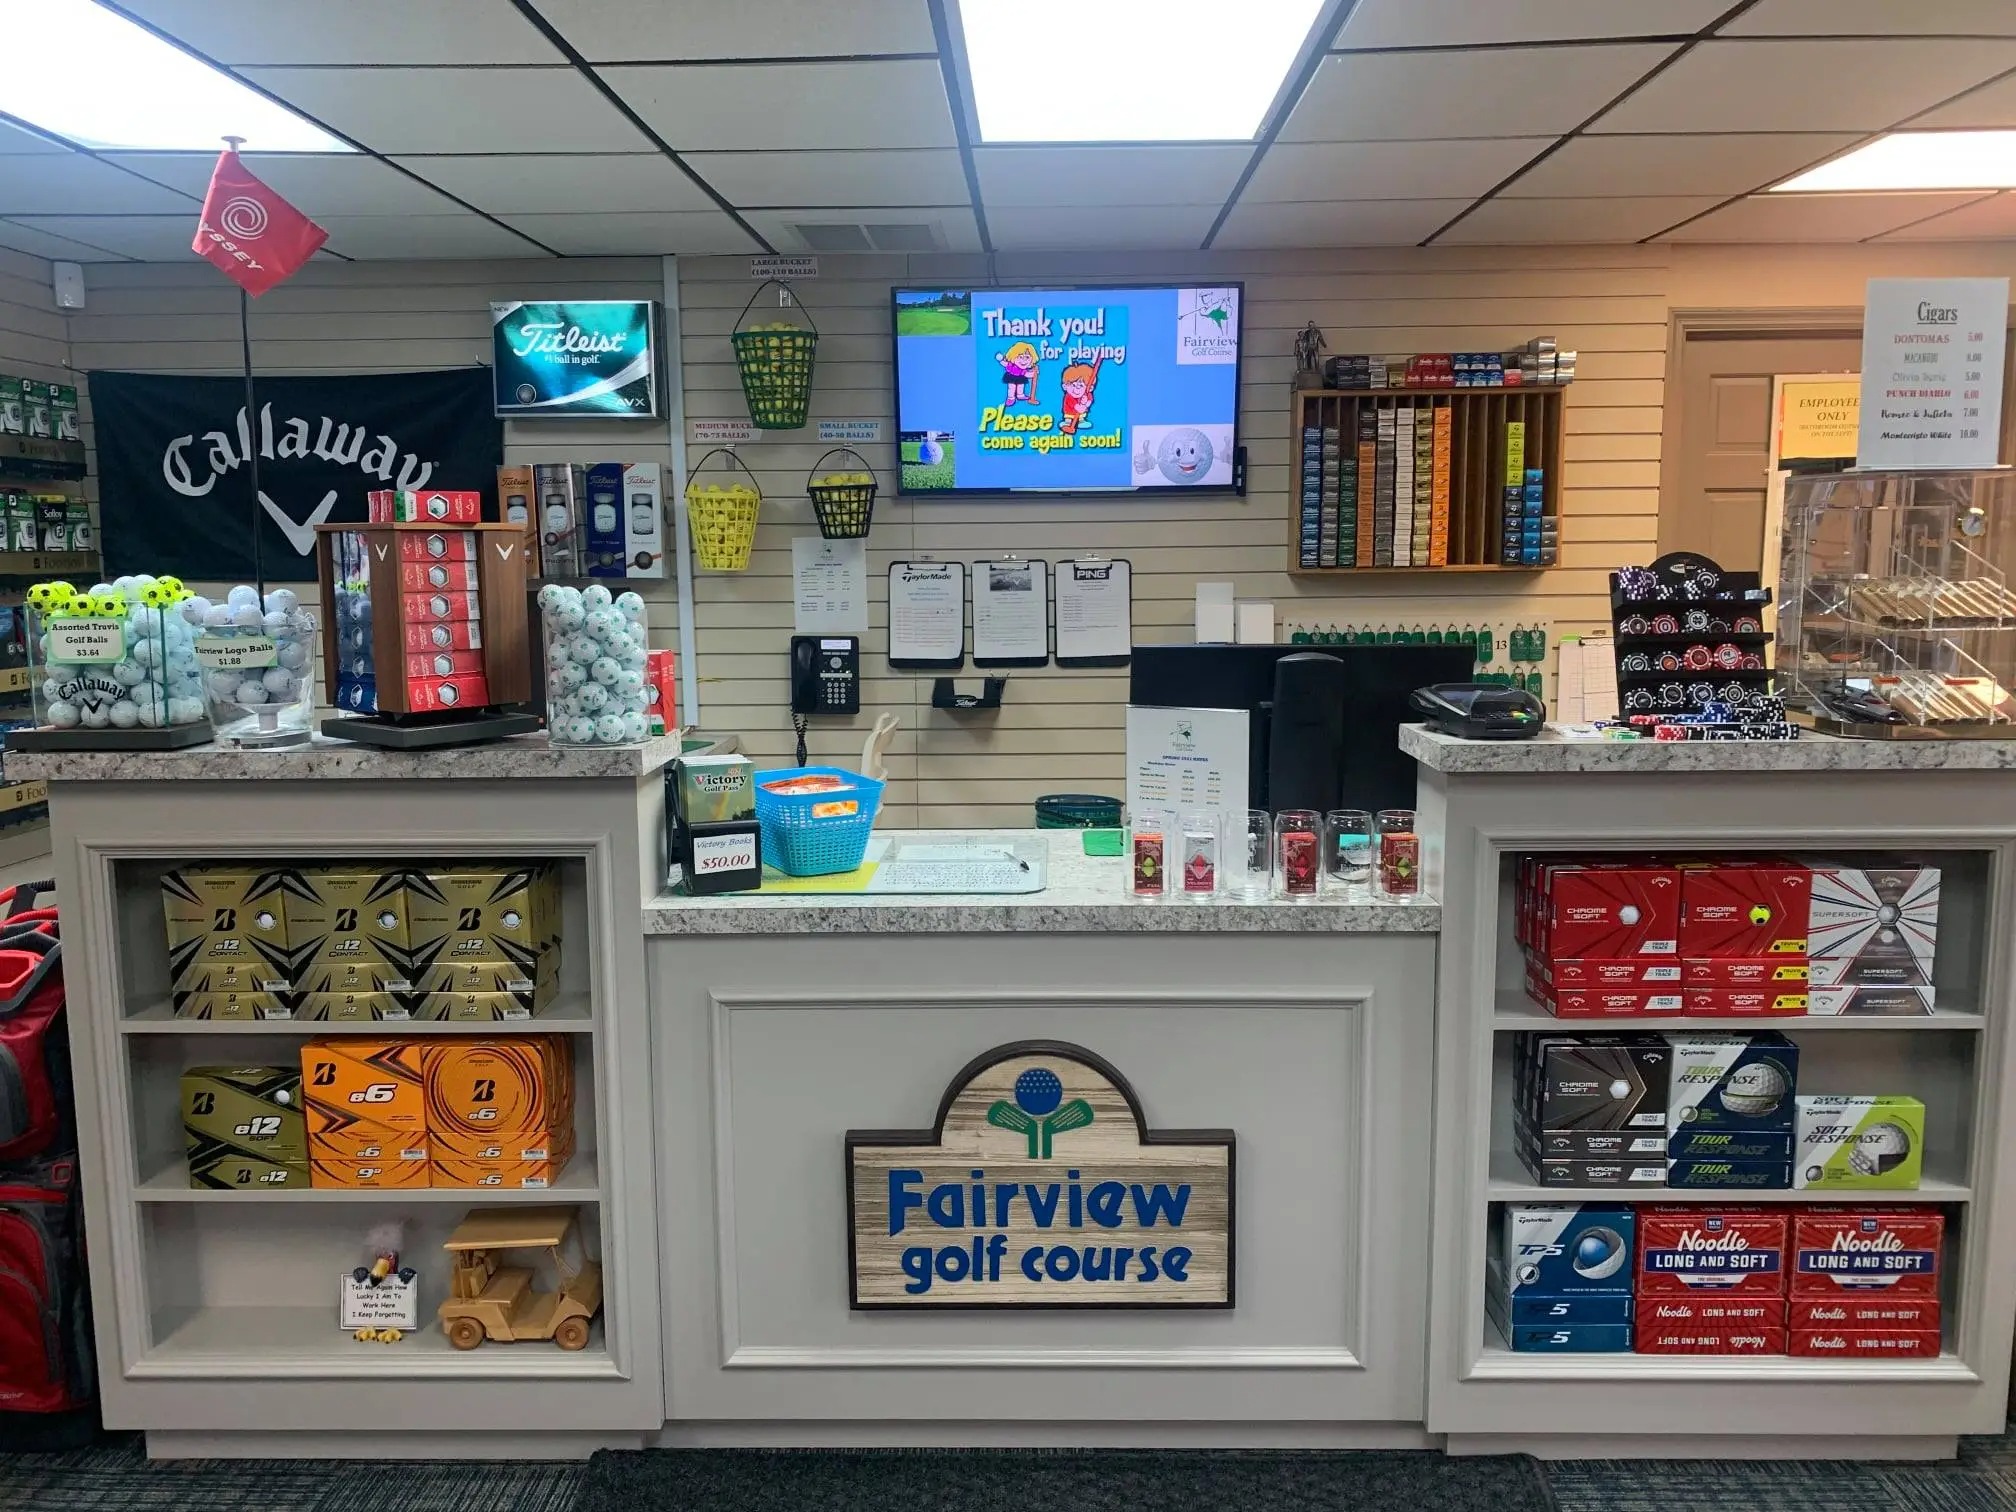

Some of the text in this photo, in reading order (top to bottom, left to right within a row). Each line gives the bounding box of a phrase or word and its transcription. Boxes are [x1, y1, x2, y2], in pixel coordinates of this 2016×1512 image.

[1918, 301, 1958, 323] Cigars
[982, 308, 1104, 344] Thank you!
[513, 322, 624, 357] Titleist
[1183, 336, 1238, 348] Fairview
[554, 354, 570, 364] ball
[571, 354, 580, 364] in
[1039, 342, 1126, 365] for playing
[617, 398, 645, 407] AVX
[979, 405, 1053, 432] Please
[1817, 411, 1850, 421] ONLY
[981, 428, 1121, 453] come again soon!
[163, 401, 434, 498] Callaway
[902, 572, 952, 582] TaylorMade
[1076, 569, 1106, 578] PING
[52, 622, 119, 631] Assorted Truvis
[65, 636, 108, 644] Golf Balls
[1495, 640, 1508, 650] 13
[76, 648, 100, 657] $3.64
[225, 647, 247, 655] Logo
[249, 643, 273, 653] Balls
[58, 678, 126, 701] Callaway
[694, 775, 747, 786] Victory
[696, 836, 753, 848] Victory Books
[701, 854, 751, 870] $50.00
[1685, 1066, 1725, 1075] TOUR
[348, 1083, 398, 1103] e6
[468, 1107, 498, 1120] e6
[234, 1115, 283, 1136] e12
[1811, 1126, 1853, 1134] SOFT
[1691, 1135, 1733, 1144] TOUR
[1803, 1134, 1888, 1144] RESPONSE
[1690, 1164, 1732, 1174] TOUR
[888, 1169, 1191, 1237] Fairview
[1677, 1229, 1750, 1252] Noodle
[1832, 1230, 1905, 1252] Noodle
[1518, 1244, 1565, 1256] TP5
[901, 1234, 1193, 1294] golf course
[1656, 1254, 1769, 1268] LONG AND SOFT
[1809, 1255, 1924, 1269] LONG AND SOFT
[356, 1293, 374, 1301] Lucky
[1656, 1305, 1693, 1318] Noodle
[1702, 1308, 1724, 1317] LONG
[1743, 1308, 1765, 1317] SOFT
[1810, 1308, 1847, 1319] Noodle
[1857, 1311, 1879, 1319] LONG
[1898, 1311, 1920, 1319] SOFT
[1657, 1337, 1679, 1345] SOFT
[1698, 1337, 1720, 1345] LONG
[1729, 1336, 1766, 1348] Noodle
[1810, 1336, 1846, 1348] Noodle
[1857, 1340, 1879, 1348] LONG
[1898, 1340, 1920, 1348] SOFT
